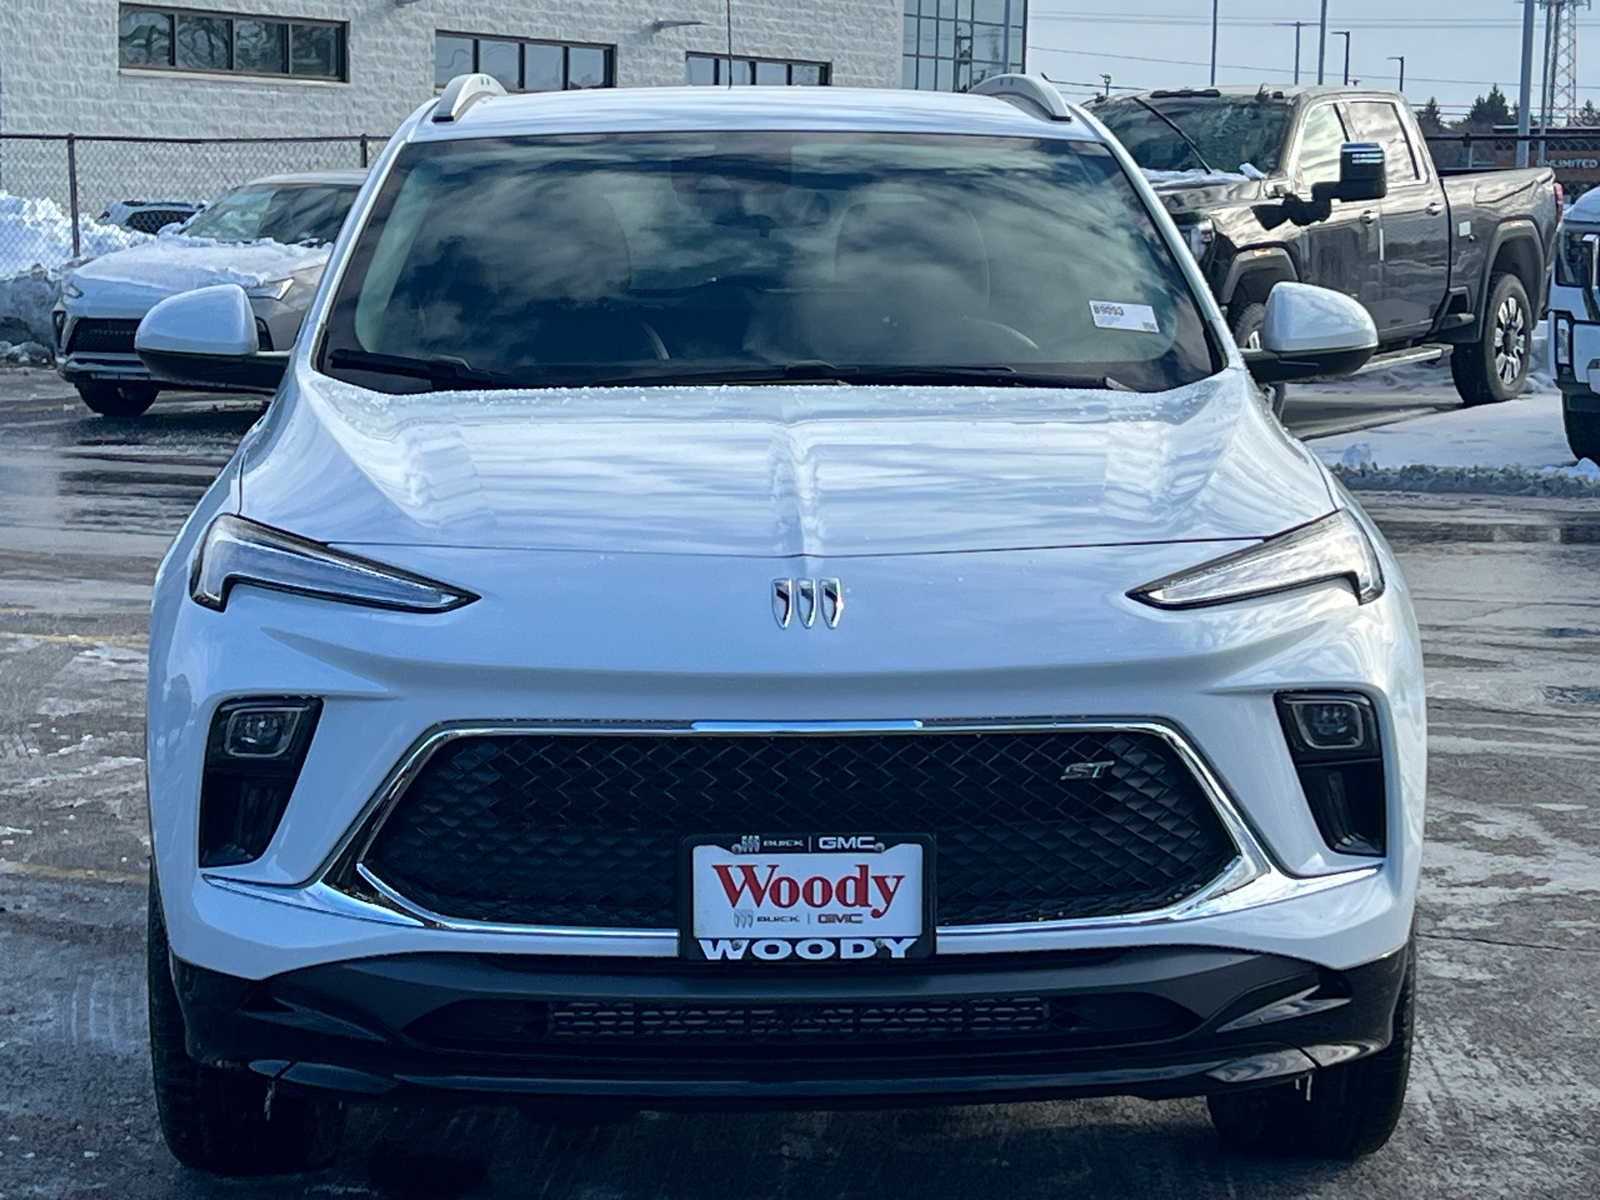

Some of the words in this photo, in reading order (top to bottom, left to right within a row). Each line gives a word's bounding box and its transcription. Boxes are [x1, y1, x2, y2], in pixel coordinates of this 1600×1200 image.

[1061, 760, 1115, 780] ST
[763, 839, 803, 847] BUICK
[818, 836, 875, 849] GMC
[712, 864, 905, 919] Woody
[818, 913, 863, 924] GMC
[699, 938, 917, 960] WOODY
